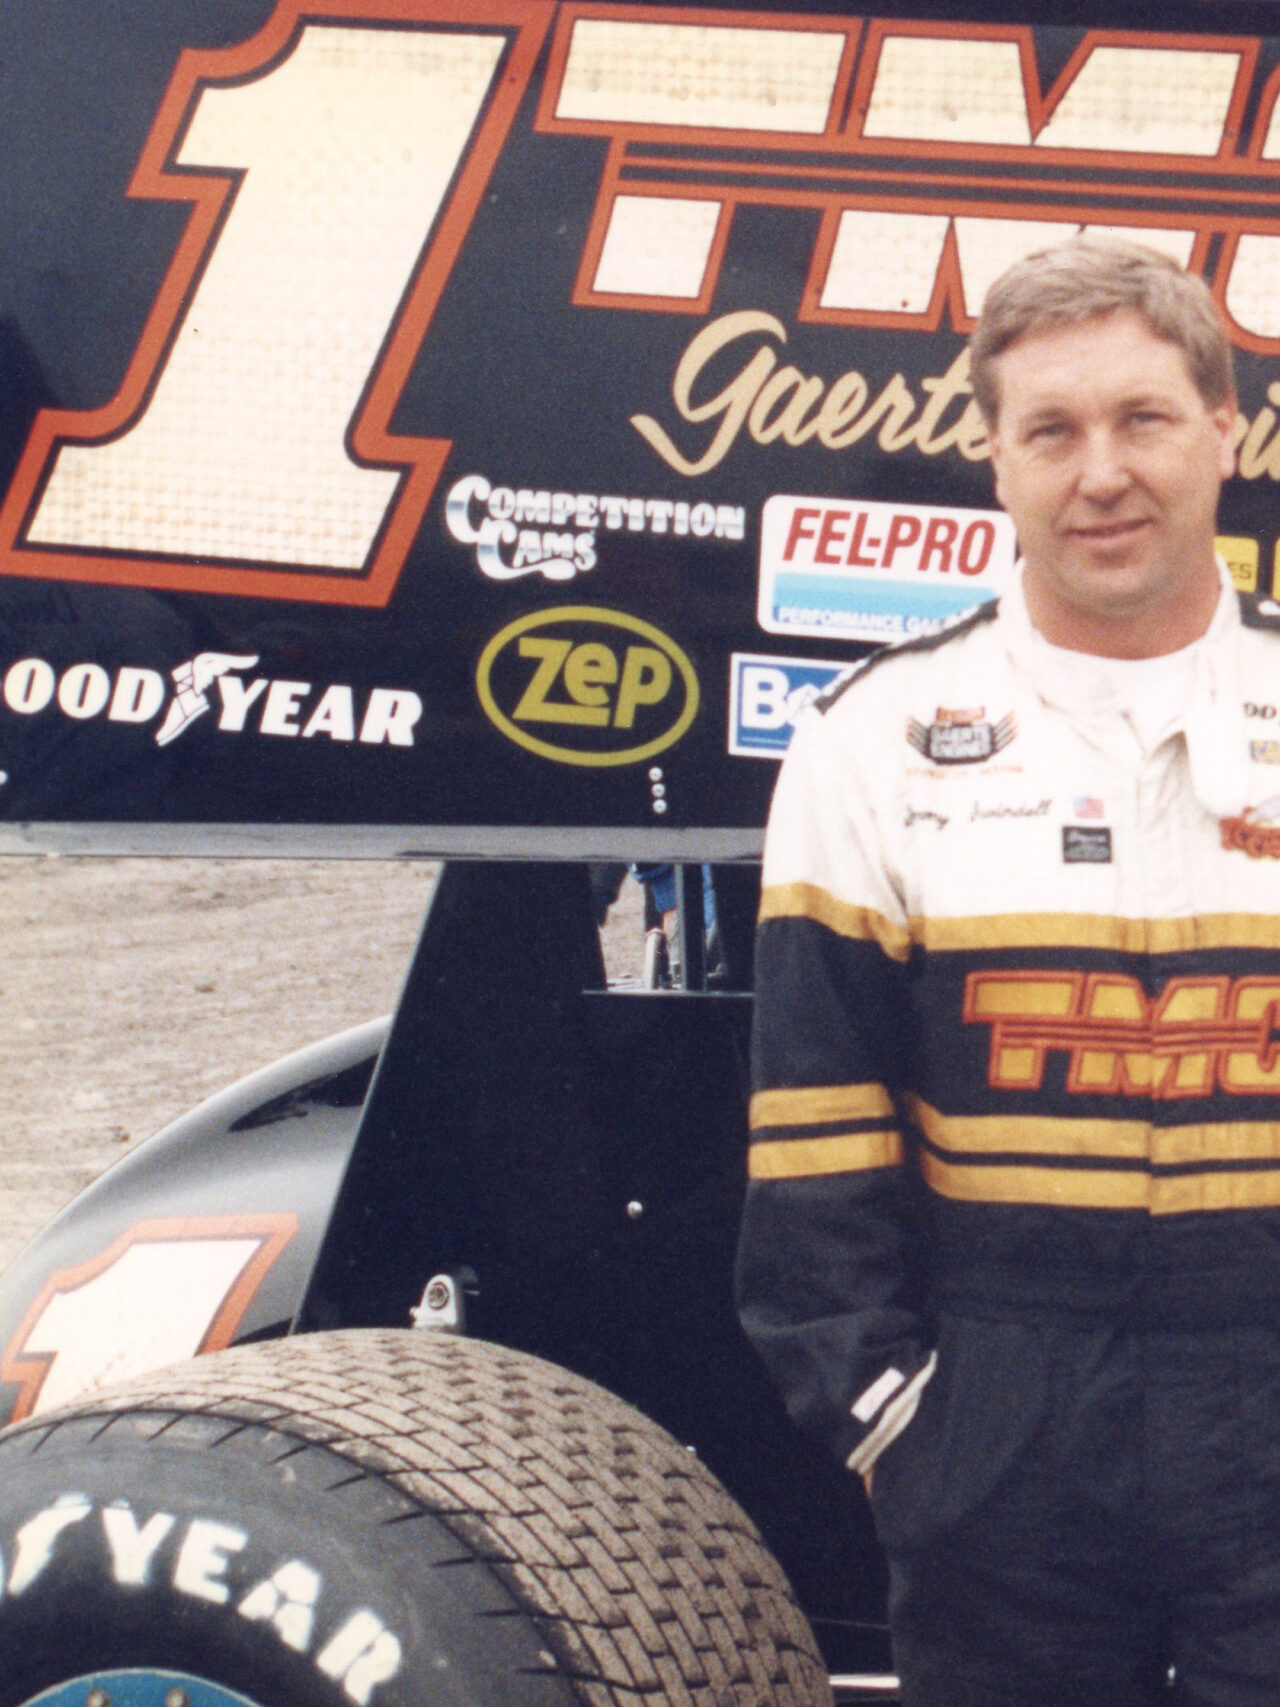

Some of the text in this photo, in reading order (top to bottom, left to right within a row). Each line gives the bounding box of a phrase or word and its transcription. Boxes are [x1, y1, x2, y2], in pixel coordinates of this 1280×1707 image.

[0, 0, 557, 607] 1
[446, 475, 746, 543] COMPETITION
[781, 507, 996, 577] FEL-PRO
[477, 518, 597, 580] CAMS
